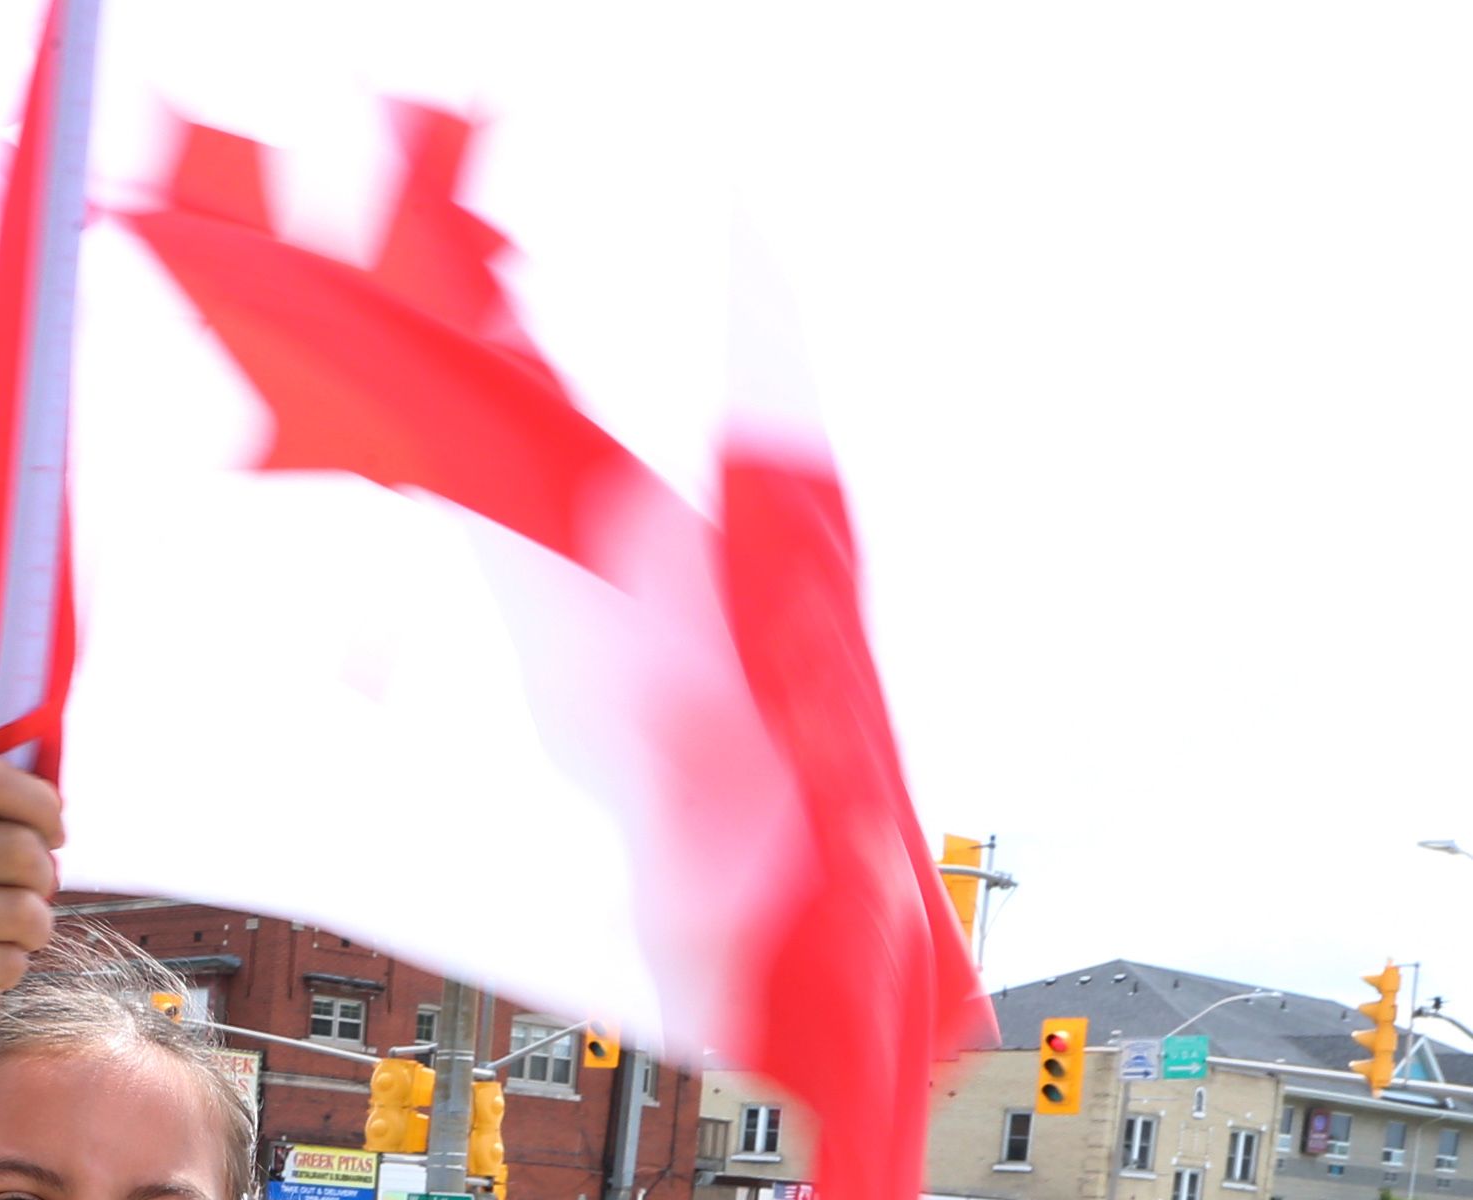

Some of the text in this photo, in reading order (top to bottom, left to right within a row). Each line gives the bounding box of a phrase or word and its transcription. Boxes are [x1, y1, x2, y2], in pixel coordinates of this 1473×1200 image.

[293, 1151, 374, 1173] GREEK PITAS
[300, 1186, 316, 1194] OUT
[323, 1188, 359, 1197] DELIVERY
